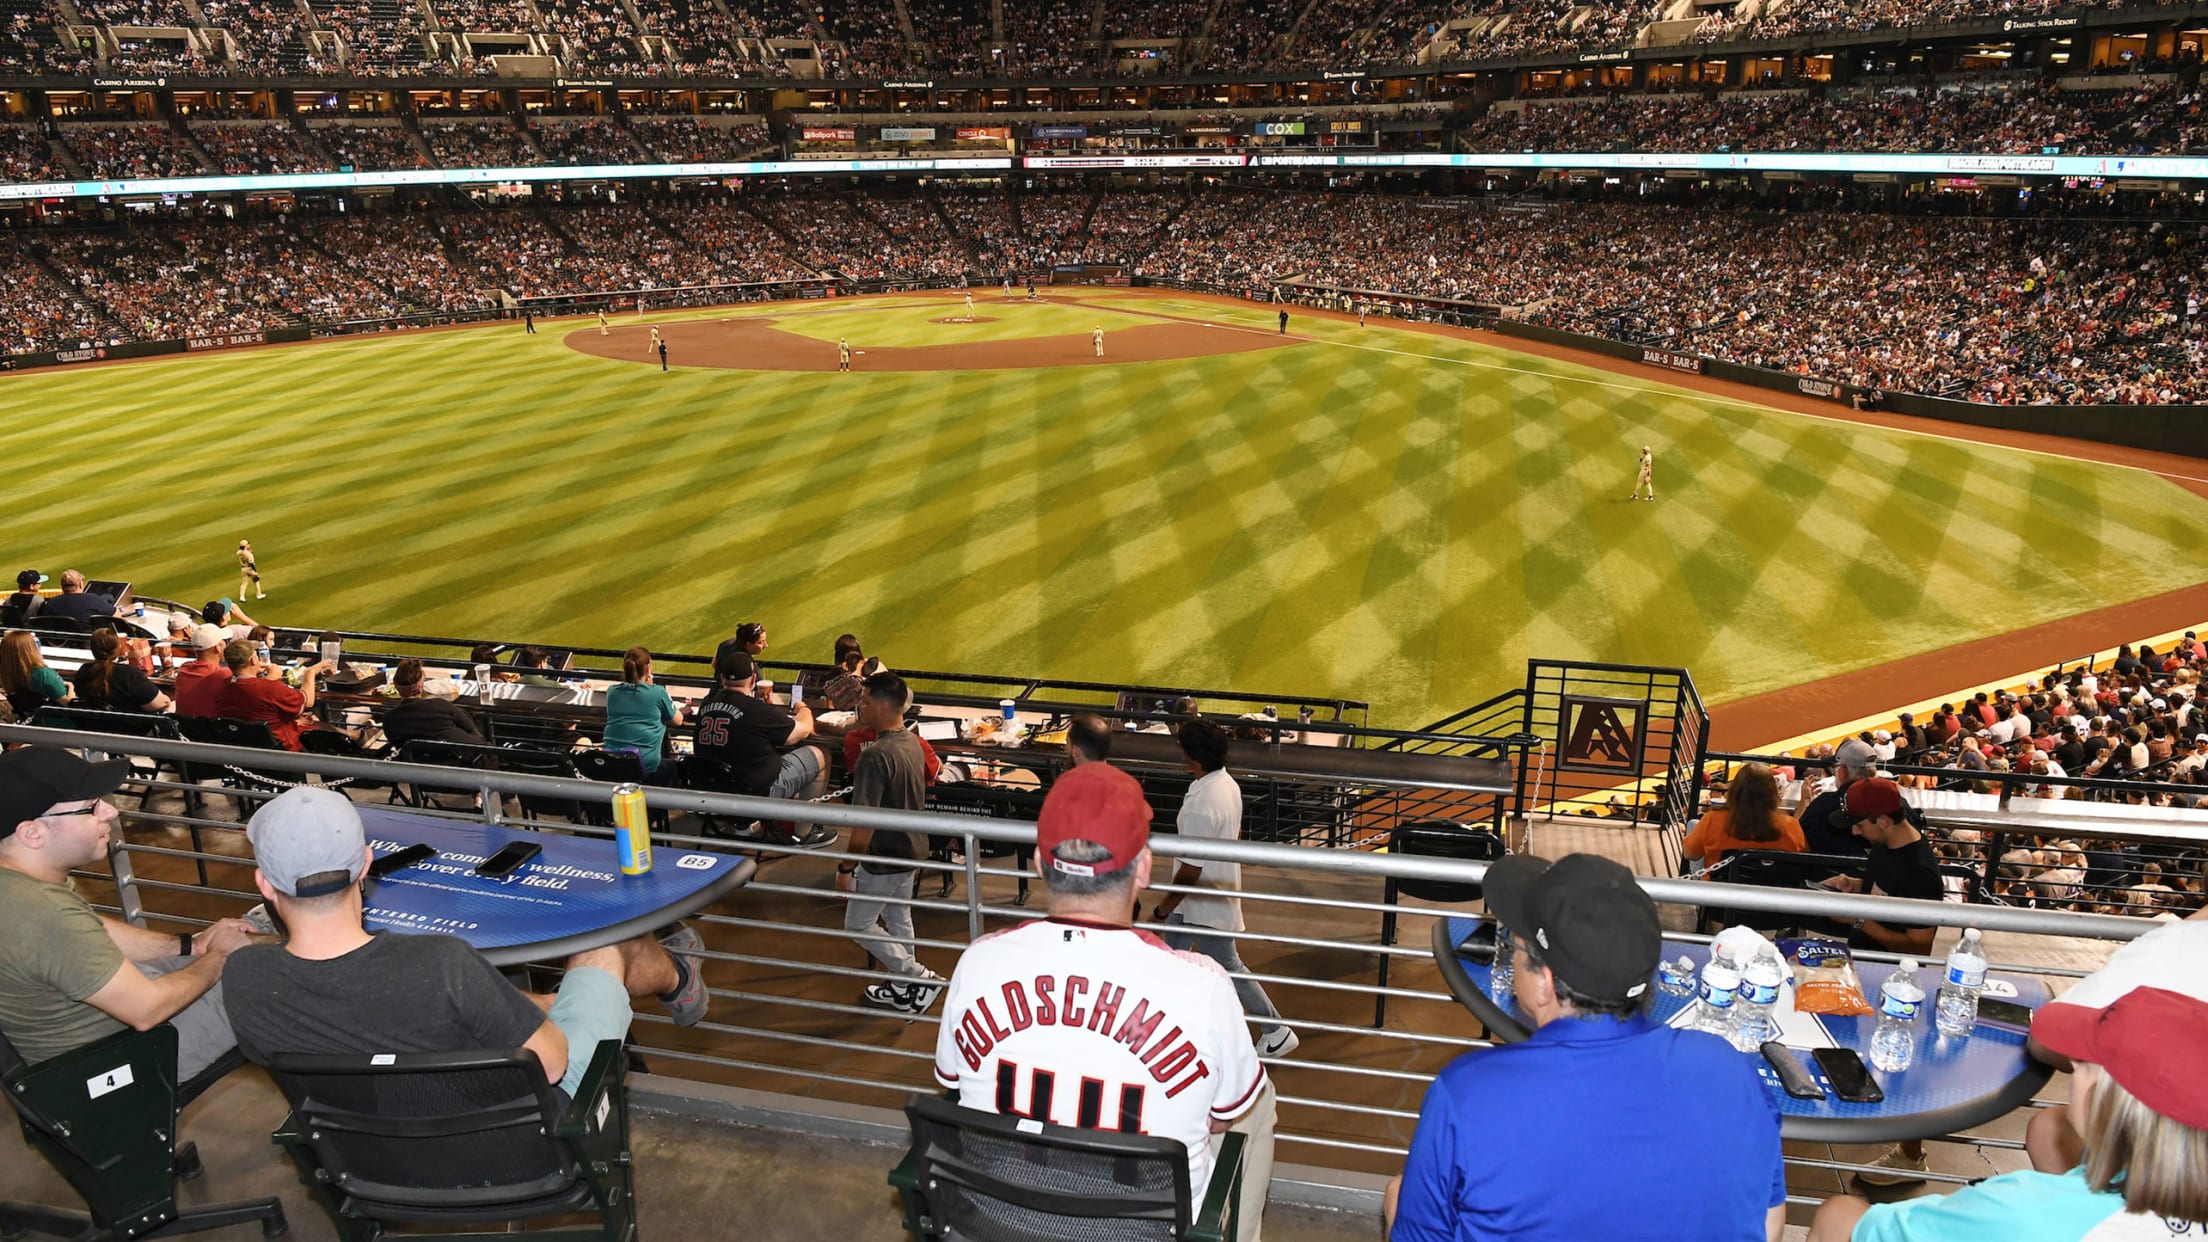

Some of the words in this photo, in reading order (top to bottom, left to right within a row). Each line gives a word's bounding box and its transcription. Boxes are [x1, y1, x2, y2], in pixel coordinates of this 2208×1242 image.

[1266, 123, 1294, 135] COX
[190, 337, 224, 349] BAR-S
[230, 333, 263, 345] BAR-S
[701, 702, 744, 719] CELEBRATING
[699, 716, 730, 747] 25
[684, 857, 710, 867] B5
[529, 863, 616, 884] wellness,
[519, 874, 569, 891] field.
[433, 918, 478, 930] FIELD
[955, 975, 1209, 1099] GOLDSCHMIDT
[107, 1075, 115, 1086] 4
